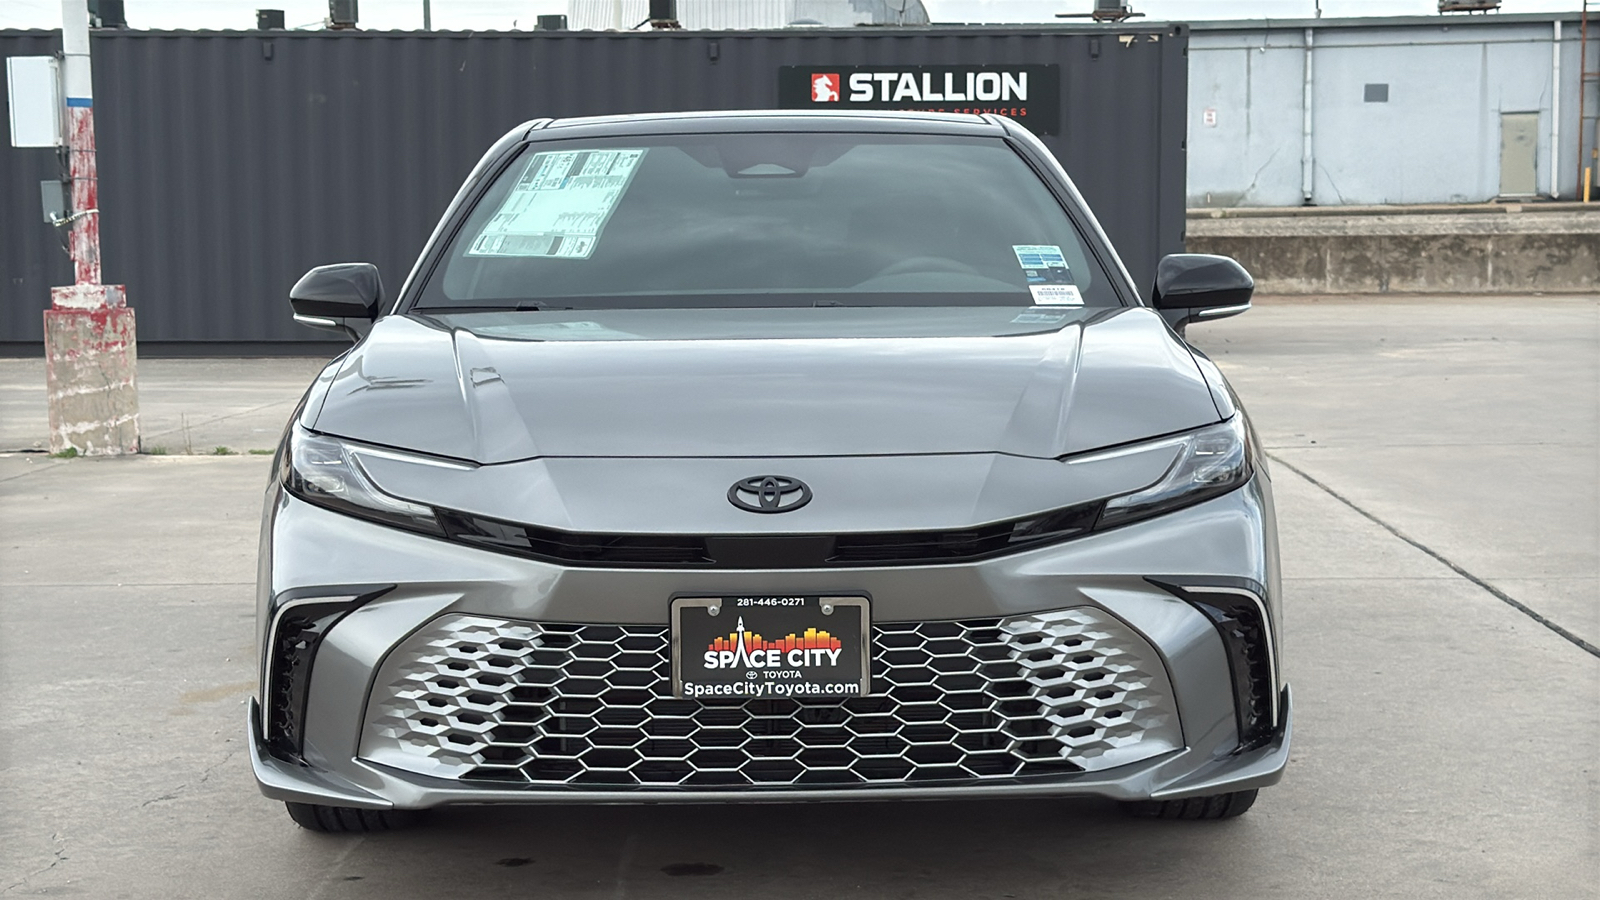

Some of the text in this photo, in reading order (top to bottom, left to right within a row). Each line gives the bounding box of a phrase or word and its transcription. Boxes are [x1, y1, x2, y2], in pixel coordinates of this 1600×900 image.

[849, 72, 1027, 101] STALLION
[737, 598, 804, 606] 281-446-0271
[704, 648, 842, 669] SPACE CITY
[763, 671, 802, 679] TOYOTA
[684, 681, 859, 697] SpaceCityToyota.com
